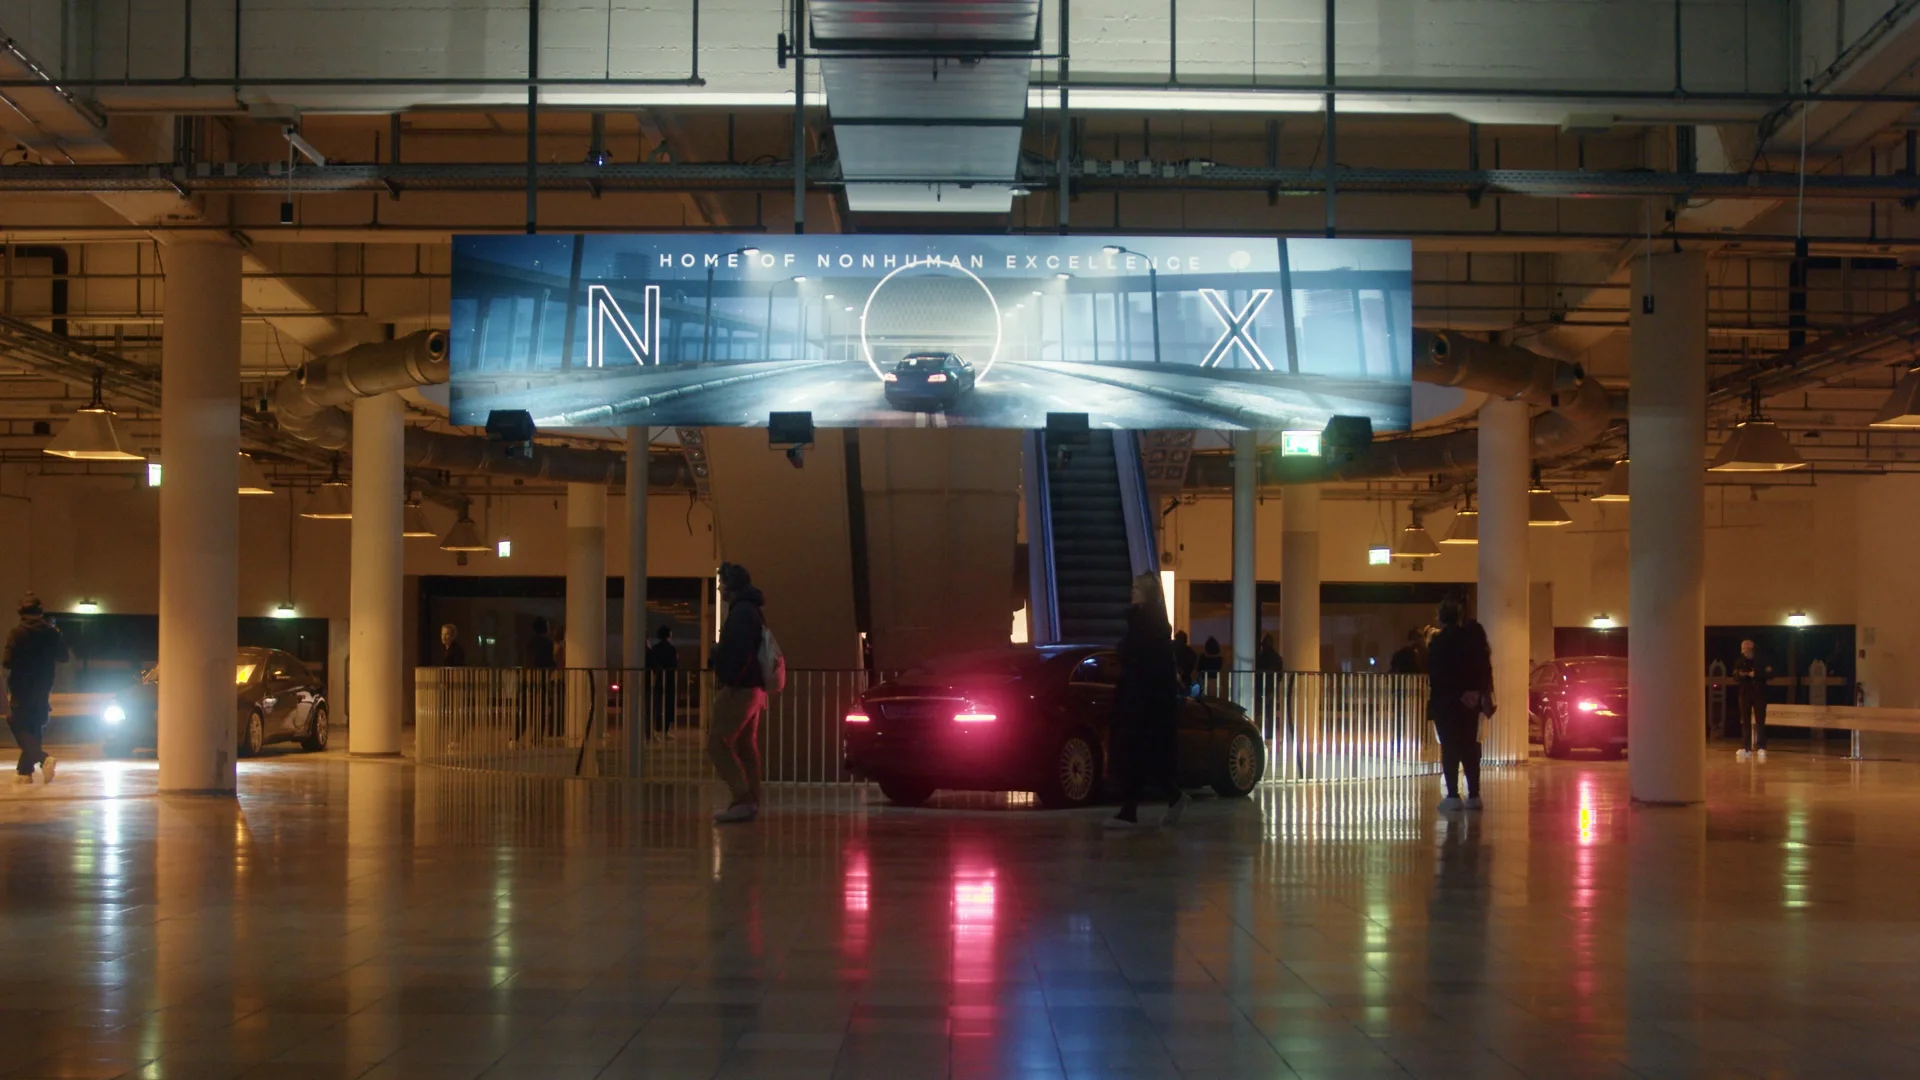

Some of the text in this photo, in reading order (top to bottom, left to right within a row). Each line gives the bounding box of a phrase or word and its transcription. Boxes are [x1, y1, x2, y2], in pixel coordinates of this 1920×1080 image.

[659, 253, 1201, 270] HOME OF NONHUMAN EXCELLENCE
